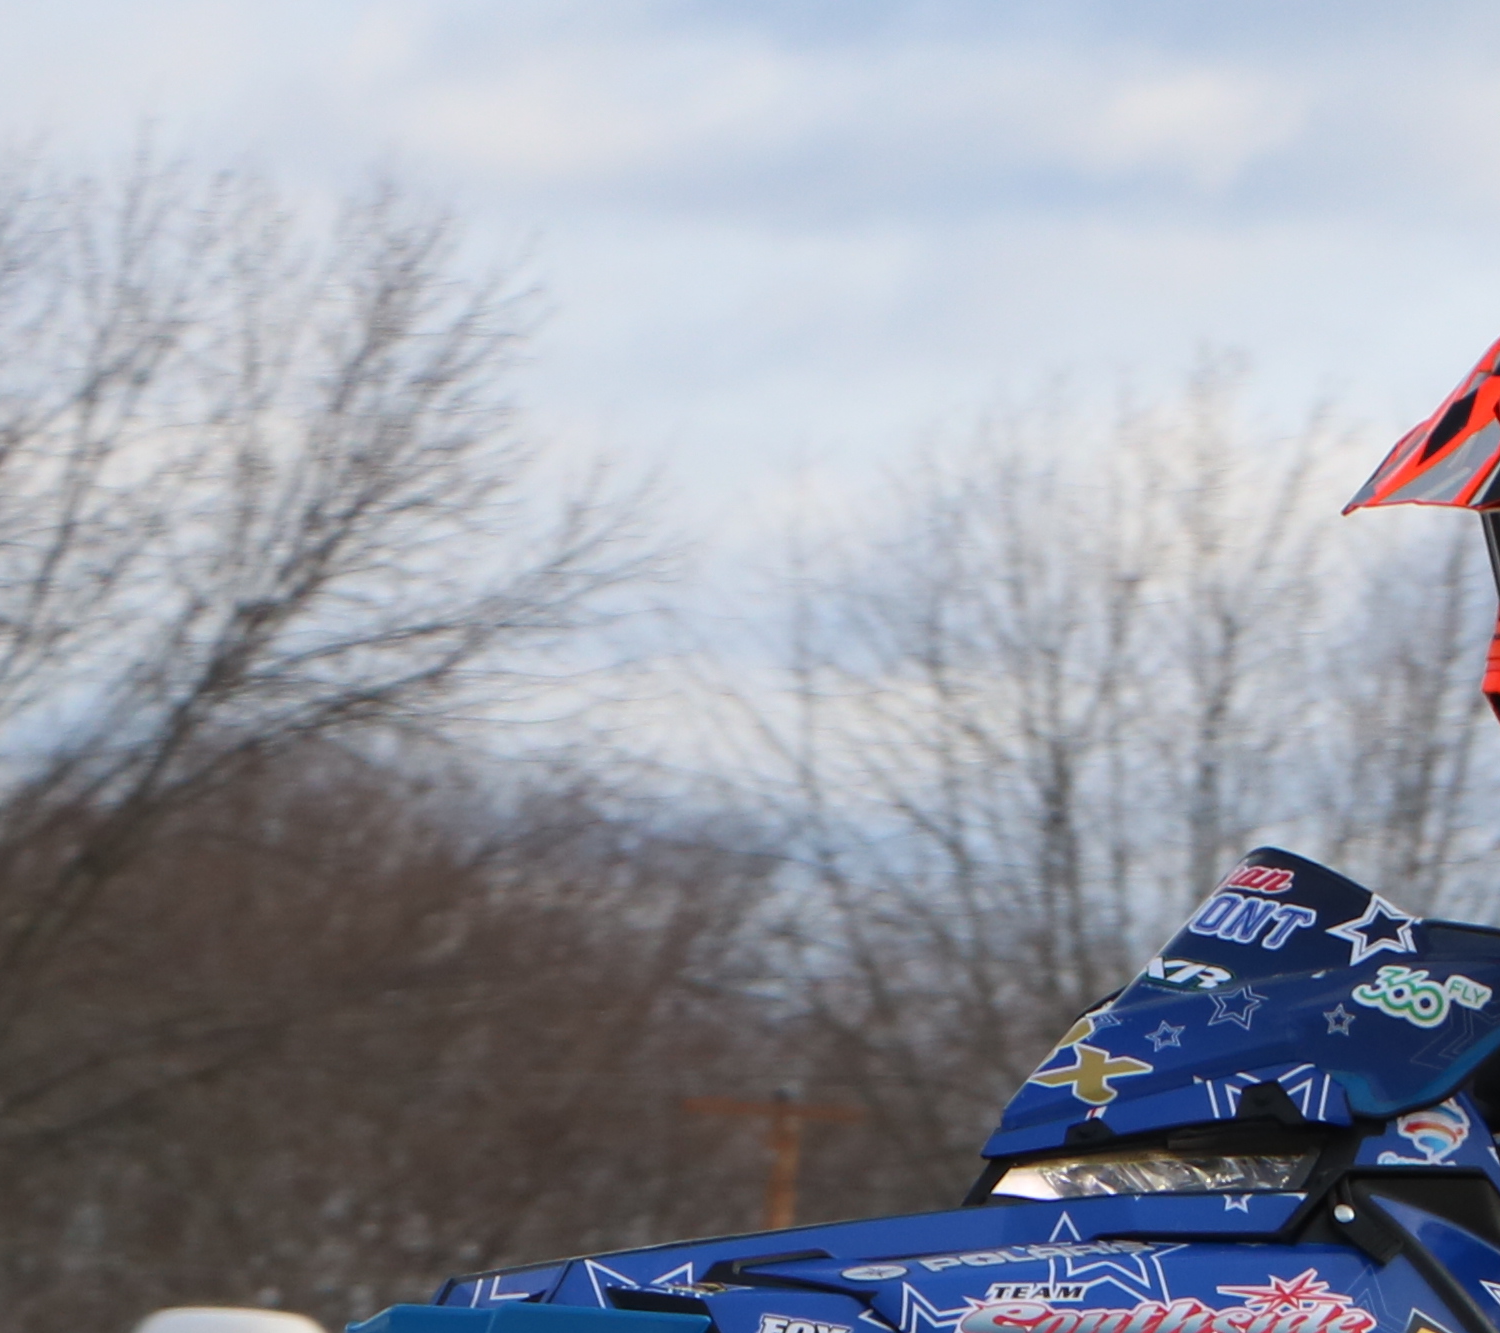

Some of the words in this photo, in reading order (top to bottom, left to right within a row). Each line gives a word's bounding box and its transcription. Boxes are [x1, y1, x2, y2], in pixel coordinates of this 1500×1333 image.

[1188, 892, 1317, 949] ONT
[1354, 966, 1447, 1028] 360
[1449, 980, 1487, 1006] FLY
[917, 1240, 1158, 1273] POLARIS
[986, 1283, 1089, 1301] TEAM
